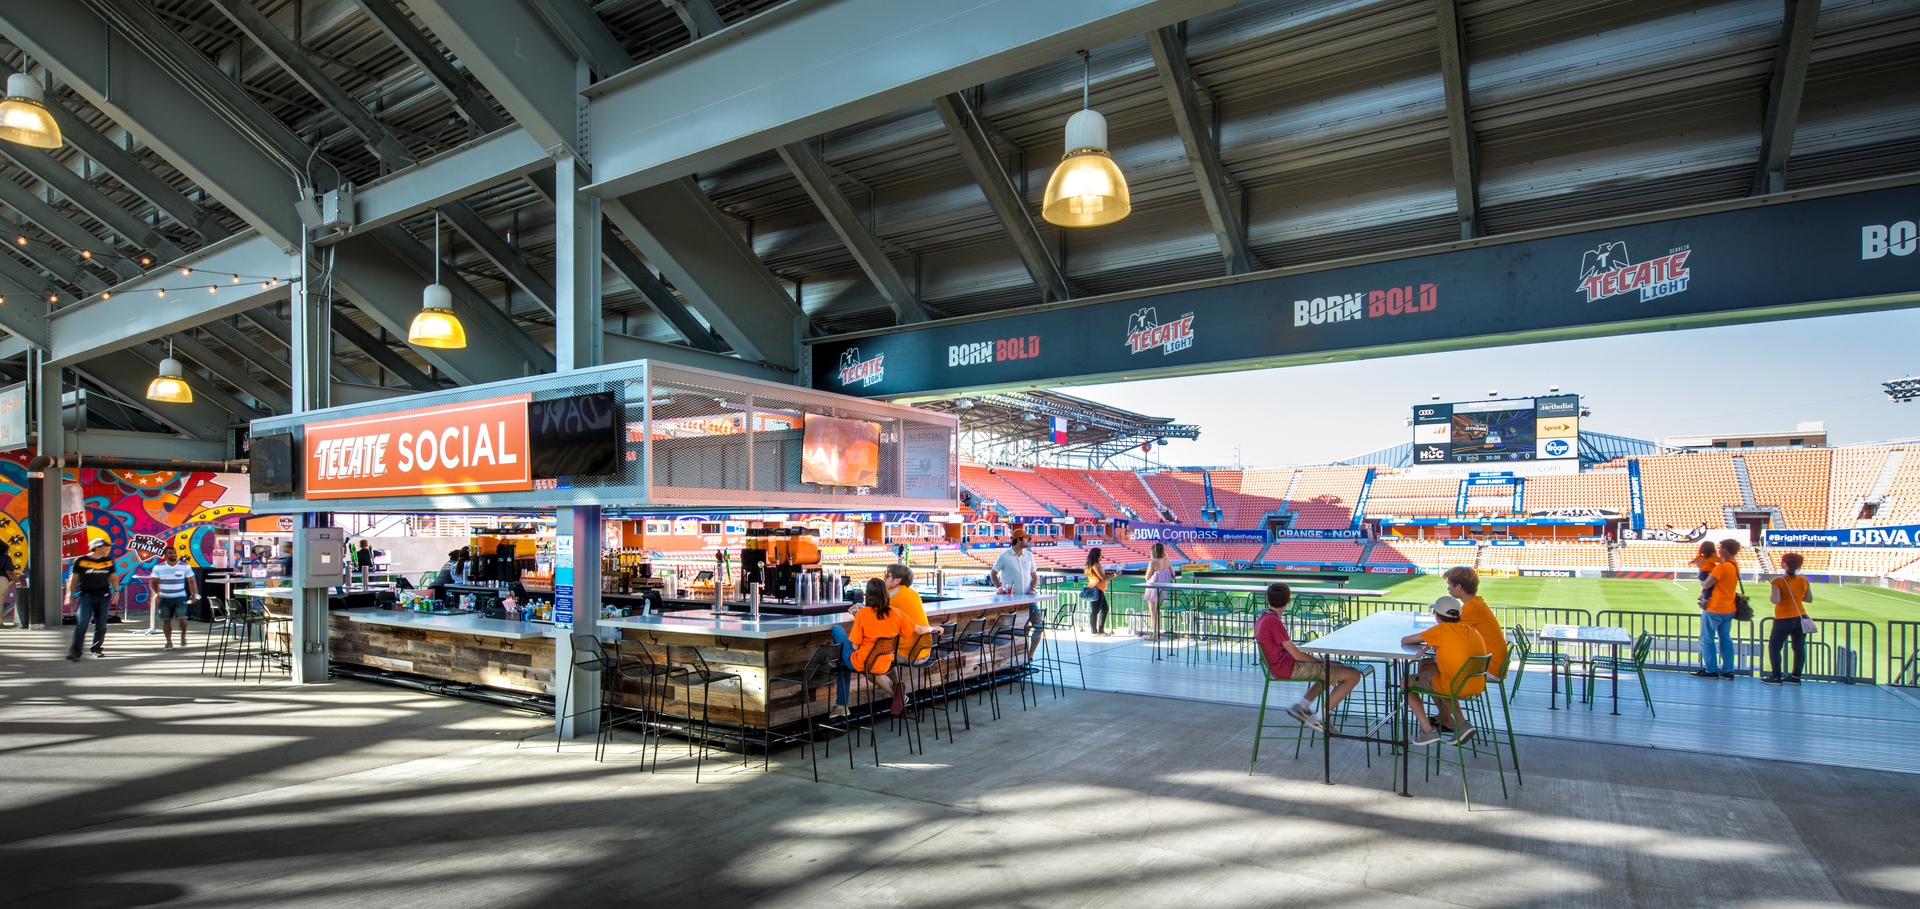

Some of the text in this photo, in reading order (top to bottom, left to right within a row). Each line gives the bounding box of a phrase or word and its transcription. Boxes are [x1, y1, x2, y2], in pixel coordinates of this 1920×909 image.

[1862, 219, 1920, 260] BO
[1578, 250, 1691, 302] TECATE
[1641, 277, 1688, 301] LIGHT
[1294, 283, 1440, 327] BORN BOLD
[1127, 316, 1194, 353] TECATE
[949, 335, 1041, 367] BORN BOLD
[1165, 337, 1192, 354] LIGHT
[840, 356, 884, 385] TECATE
[864, 372, 883, 386] LIGHT
[314, 421, 517, 480] TECATE SOCIAL
[1546, 442, 1568, 455] Kroger
[62, 511, 84, 531] ATE
[1134, 528, 1218, 540] BBVA Compass
[1278, 530, 1361, 538] ORANGE NOW
[1622, 529, 1638, 540] &
[1769, 534, 1838, 542] #BrightFutures
[1850, 530, 1910, 545] BBVA
[131, 541, 164, 556] DYNAMO
